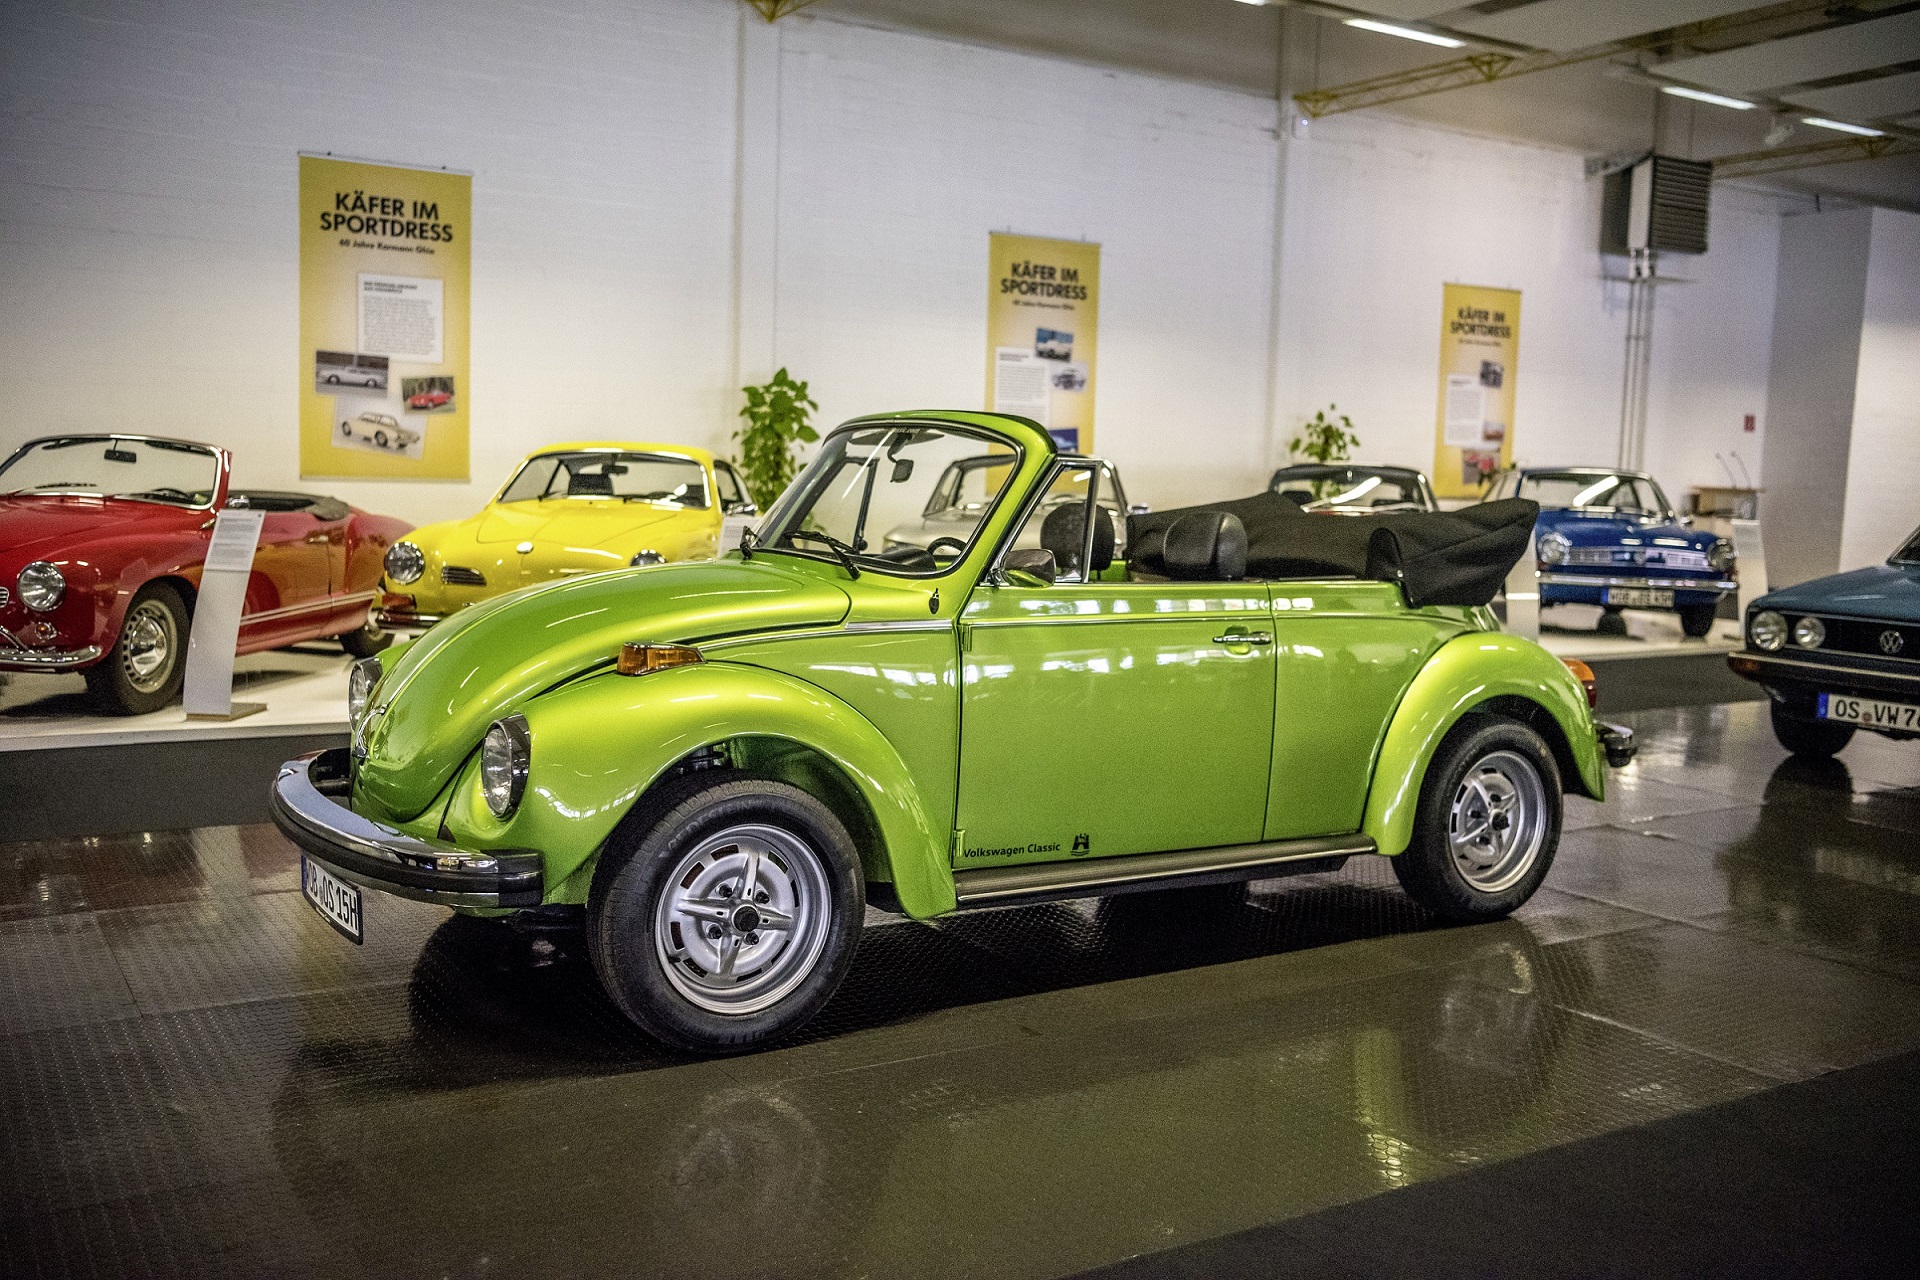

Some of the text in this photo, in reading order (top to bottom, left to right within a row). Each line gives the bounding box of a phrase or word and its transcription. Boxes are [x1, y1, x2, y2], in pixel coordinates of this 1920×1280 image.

[335, 190, 439, 220] KÄFER IM
[320, 211, 453, 242] SPORTDRESS
[1011, 260, 1079, 282] KÄFER IM
[1001, 278, 1087, 301] SPORTDRESS
[1835, 699, 1860, 719] OS
[1874, 704, 1900, 725] VW
[964, 842, 1061, 858] Volkswagen Classic
[322, 875, 335, 913] OS
[336, 886, 358, 931] 15H
